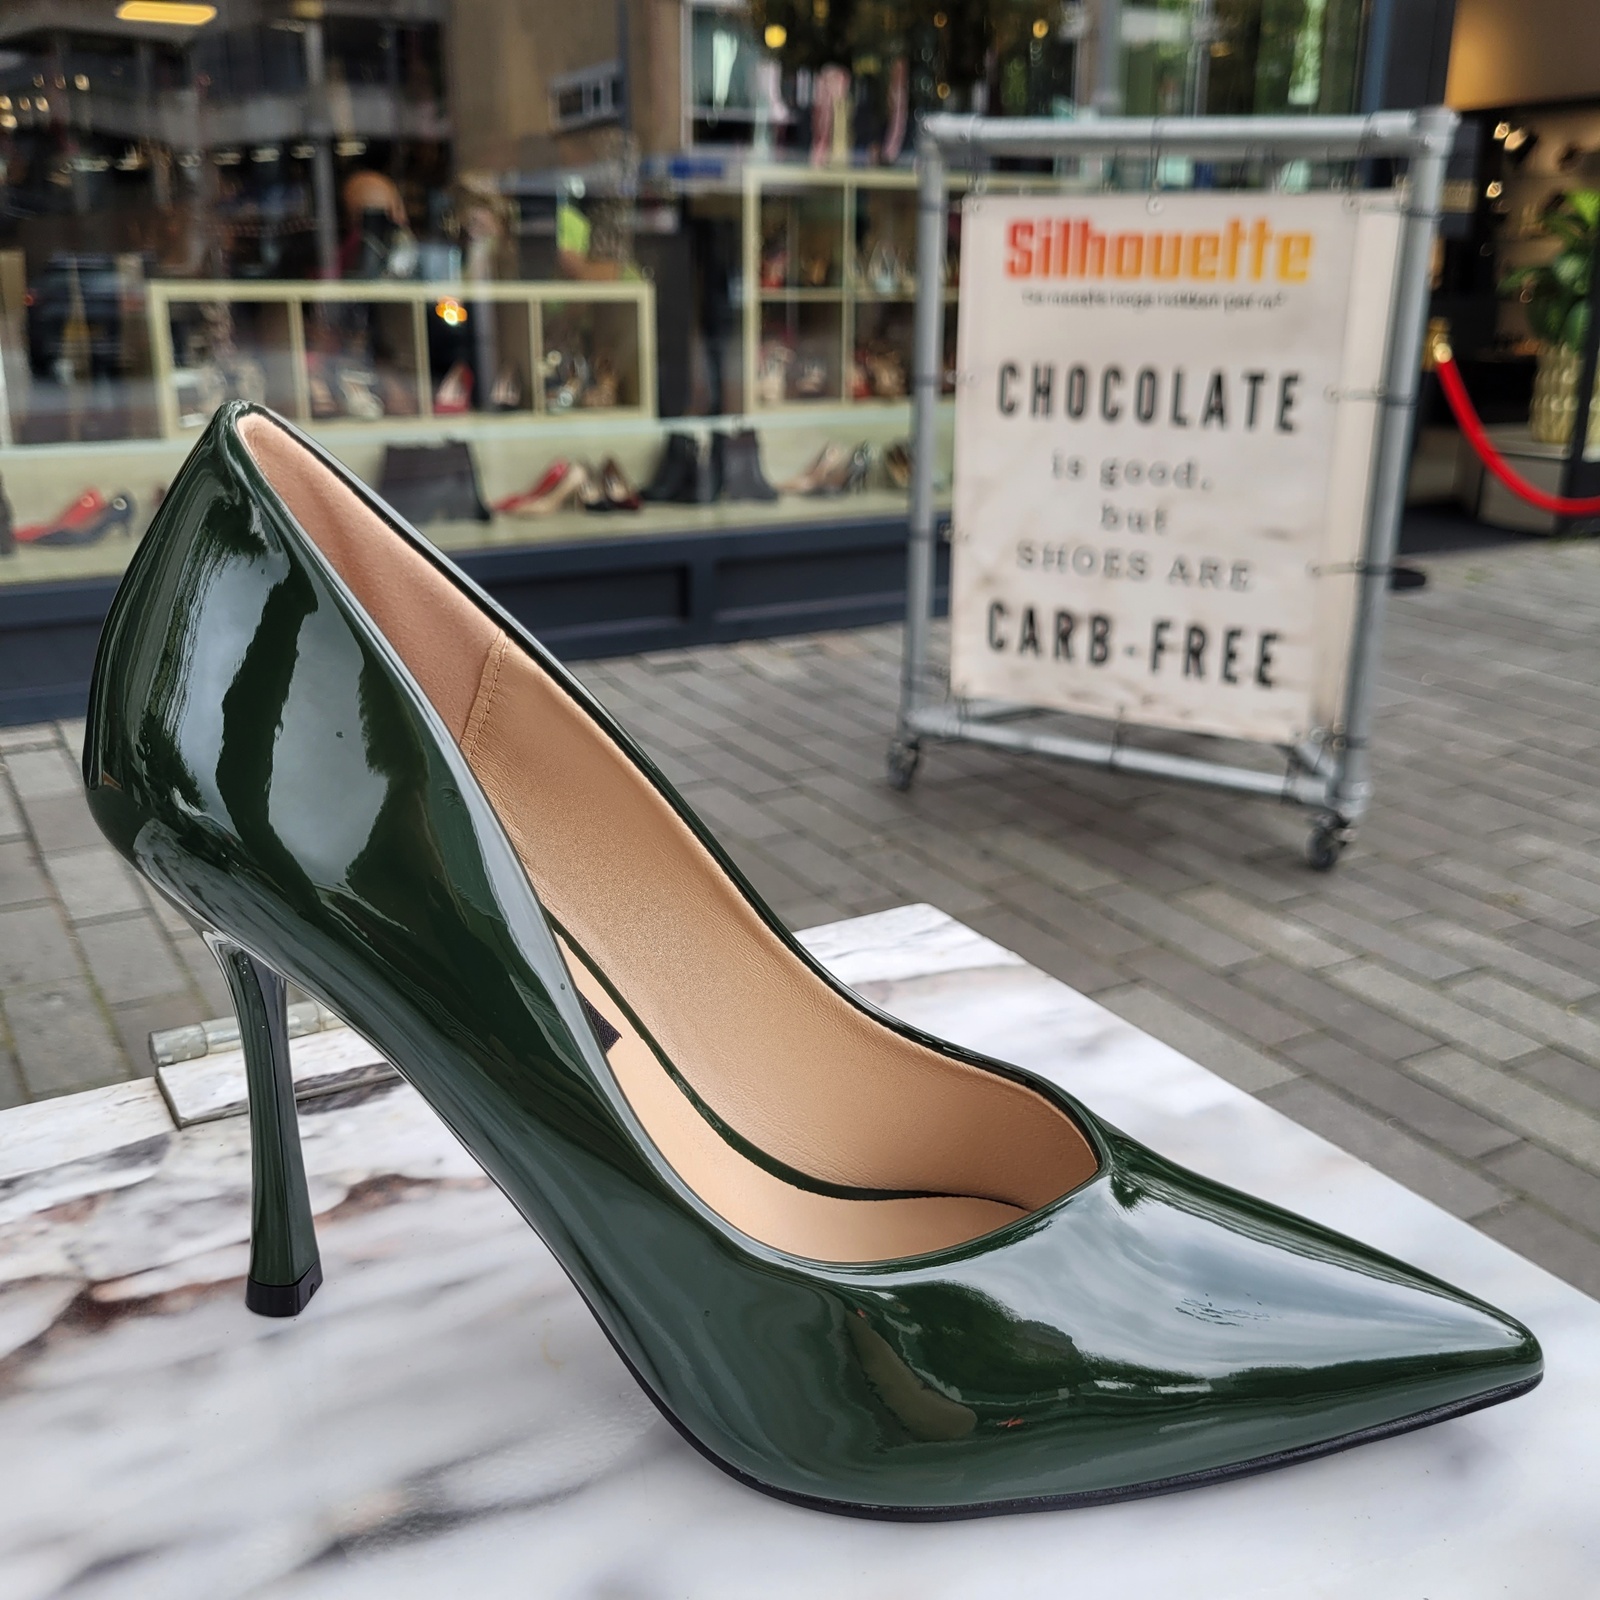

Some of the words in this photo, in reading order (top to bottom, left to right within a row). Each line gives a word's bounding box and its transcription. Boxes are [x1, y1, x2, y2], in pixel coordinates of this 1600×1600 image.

[1006, 216, 1312, 283] Silhouette
[998, 363, 1302, 432] CHOCOLATE
[1052, 450, 1083, 482] is
[1101, 502, 1168, 535] but
[1016, 540, 1149, 582] SHOES
[1167, 556, 1253, 592] ARE
